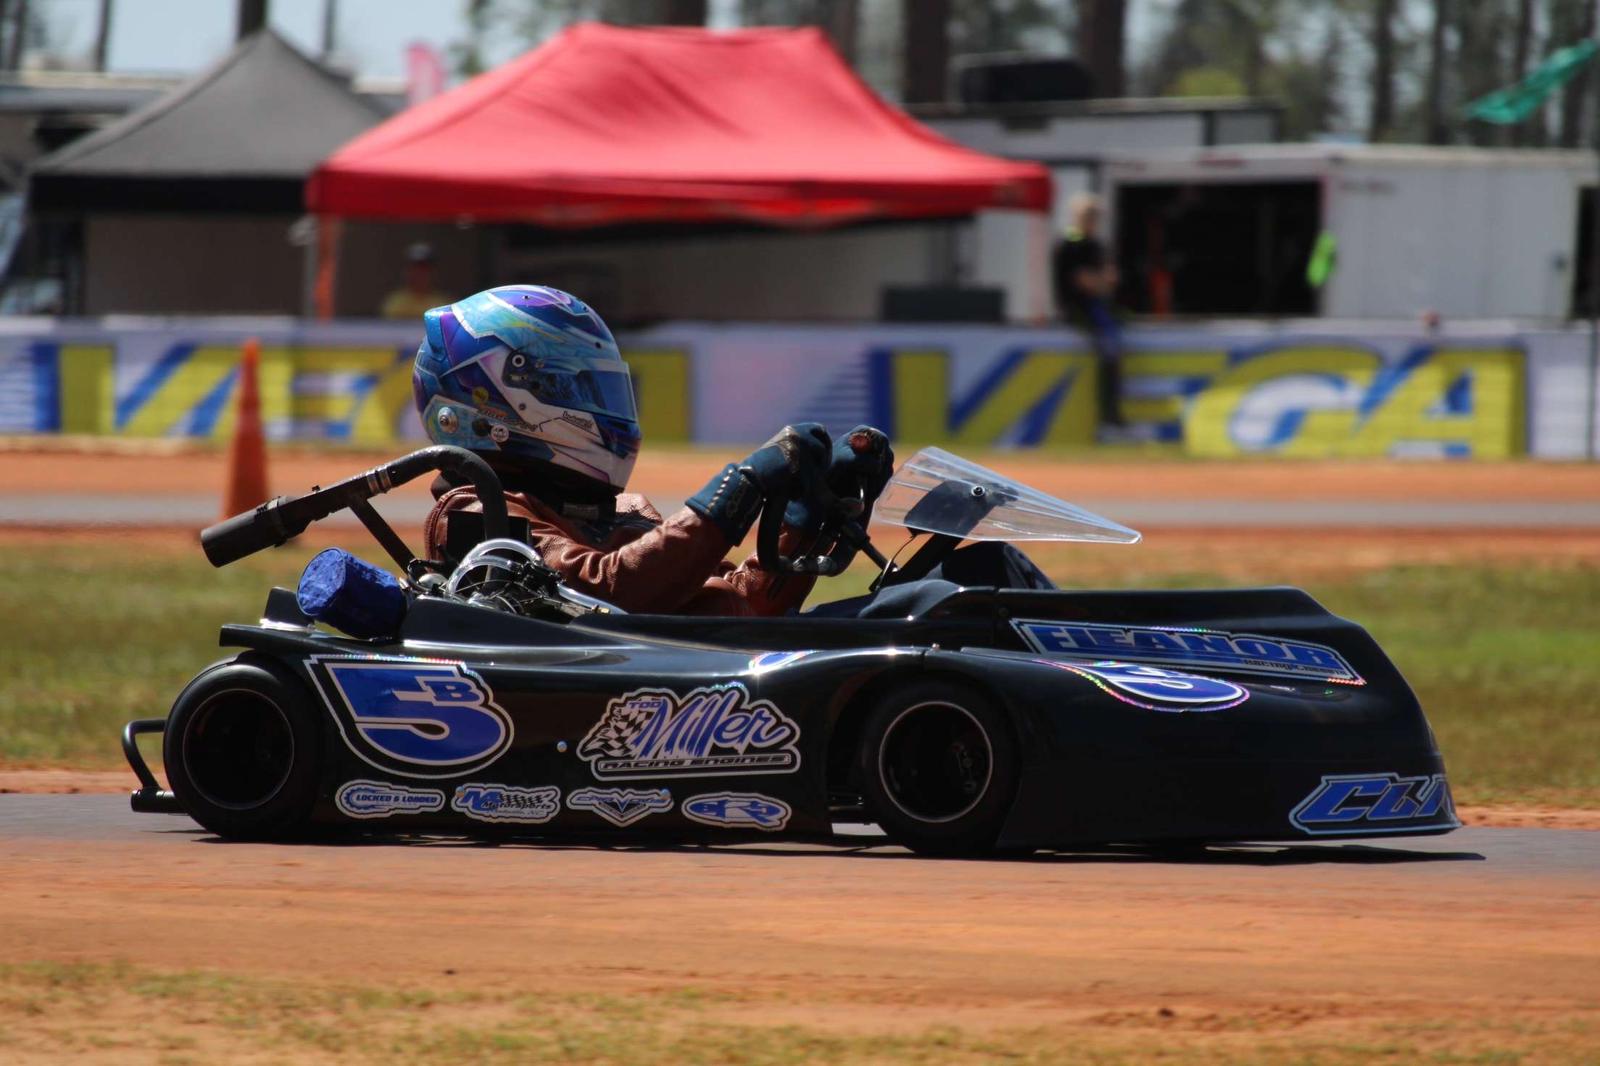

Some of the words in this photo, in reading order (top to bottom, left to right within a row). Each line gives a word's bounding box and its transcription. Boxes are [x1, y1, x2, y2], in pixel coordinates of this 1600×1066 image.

[868, 345, 1530, 458] VEGA
[631, 690, 790, 757] Miller
[603, 758, 684, 769] RACING
[690, 754, 785, 767] ENGINES
[480, 800, 553, 811] Motorsports
